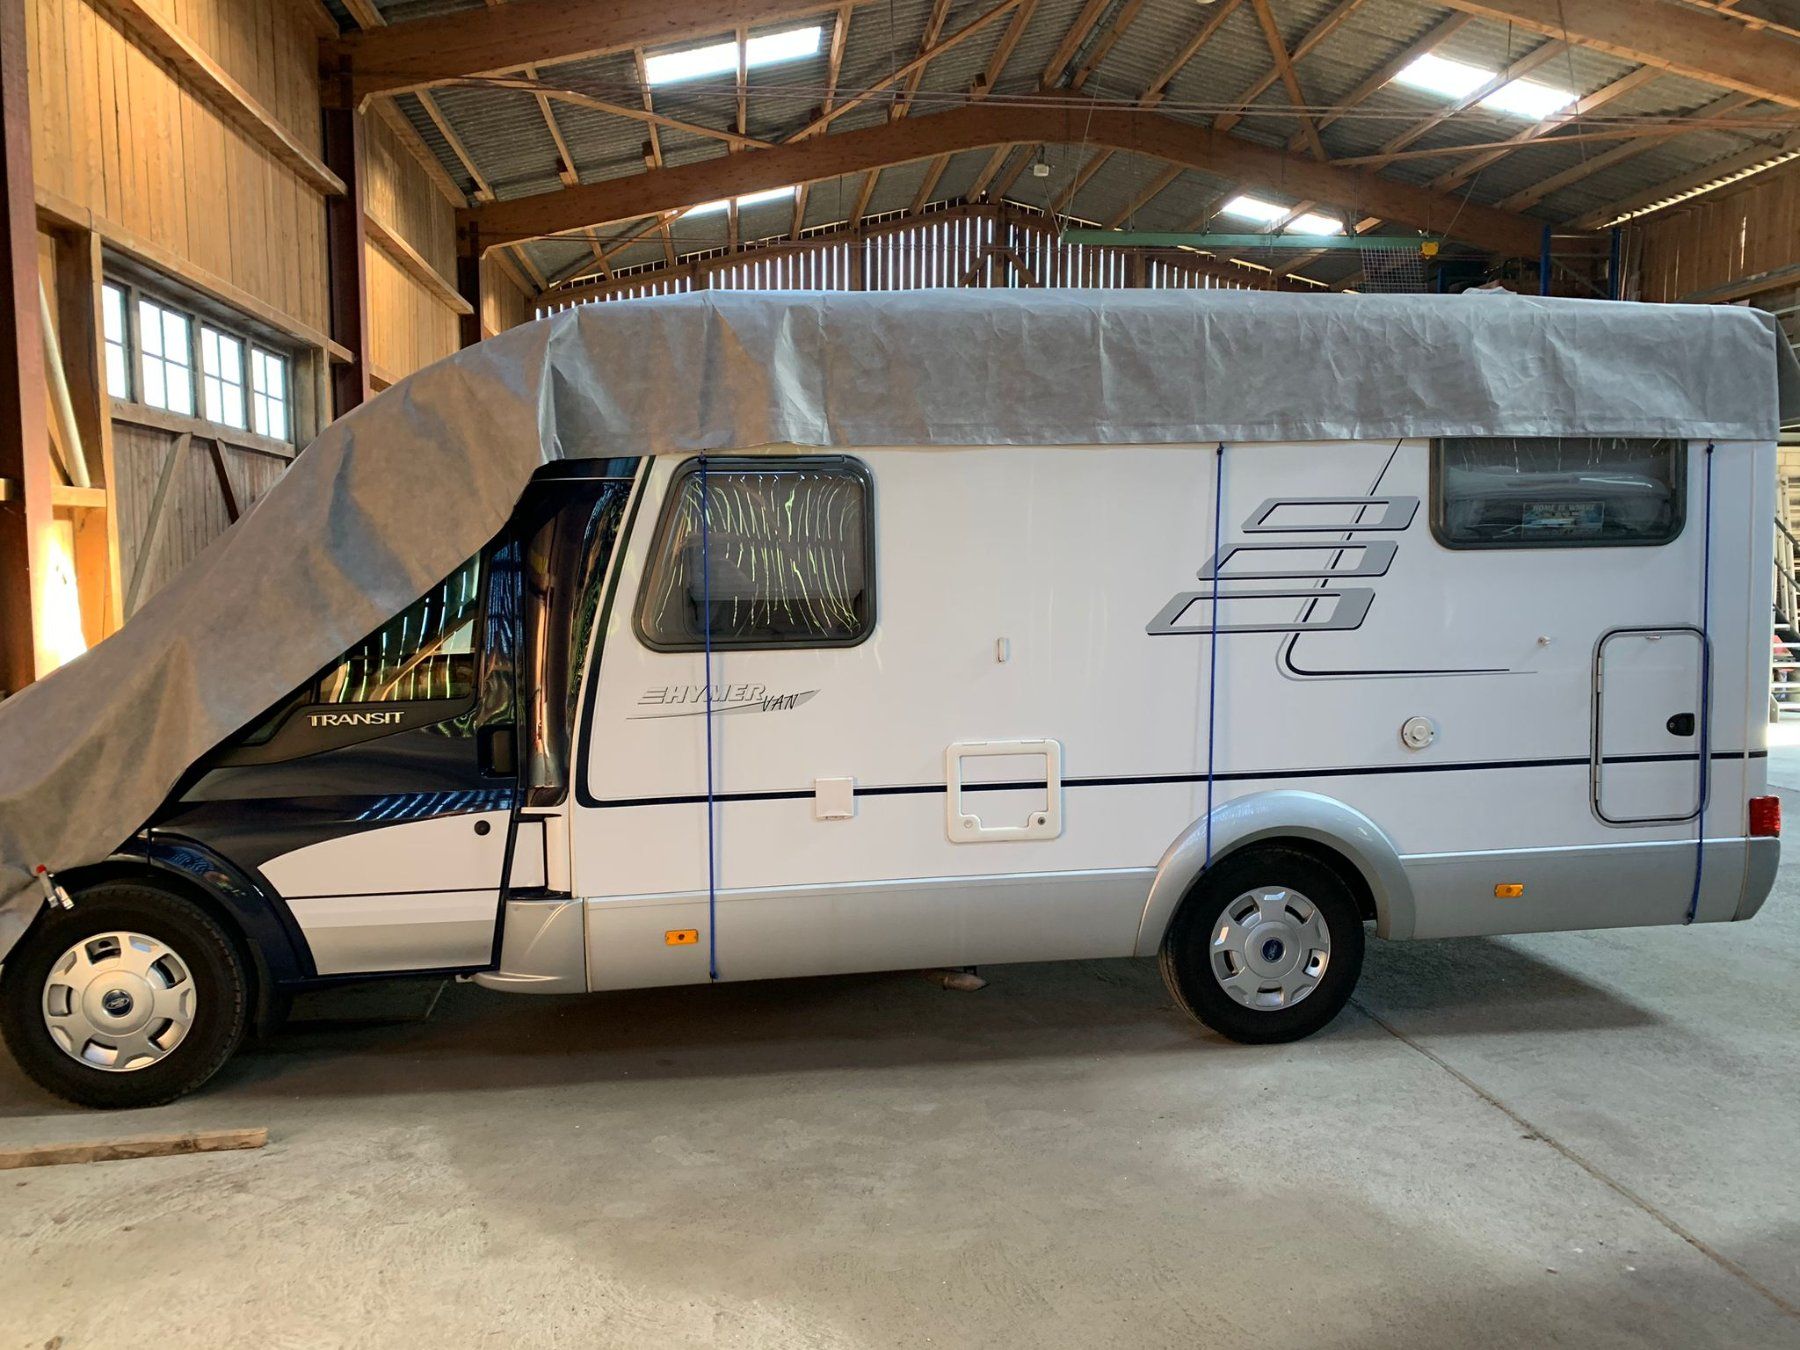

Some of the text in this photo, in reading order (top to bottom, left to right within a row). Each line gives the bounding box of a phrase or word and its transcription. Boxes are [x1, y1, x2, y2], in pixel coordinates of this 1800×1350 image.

[663, 683, 799, 712] HYMER VAN
[307, 711, 405, 727] TRANSIT
